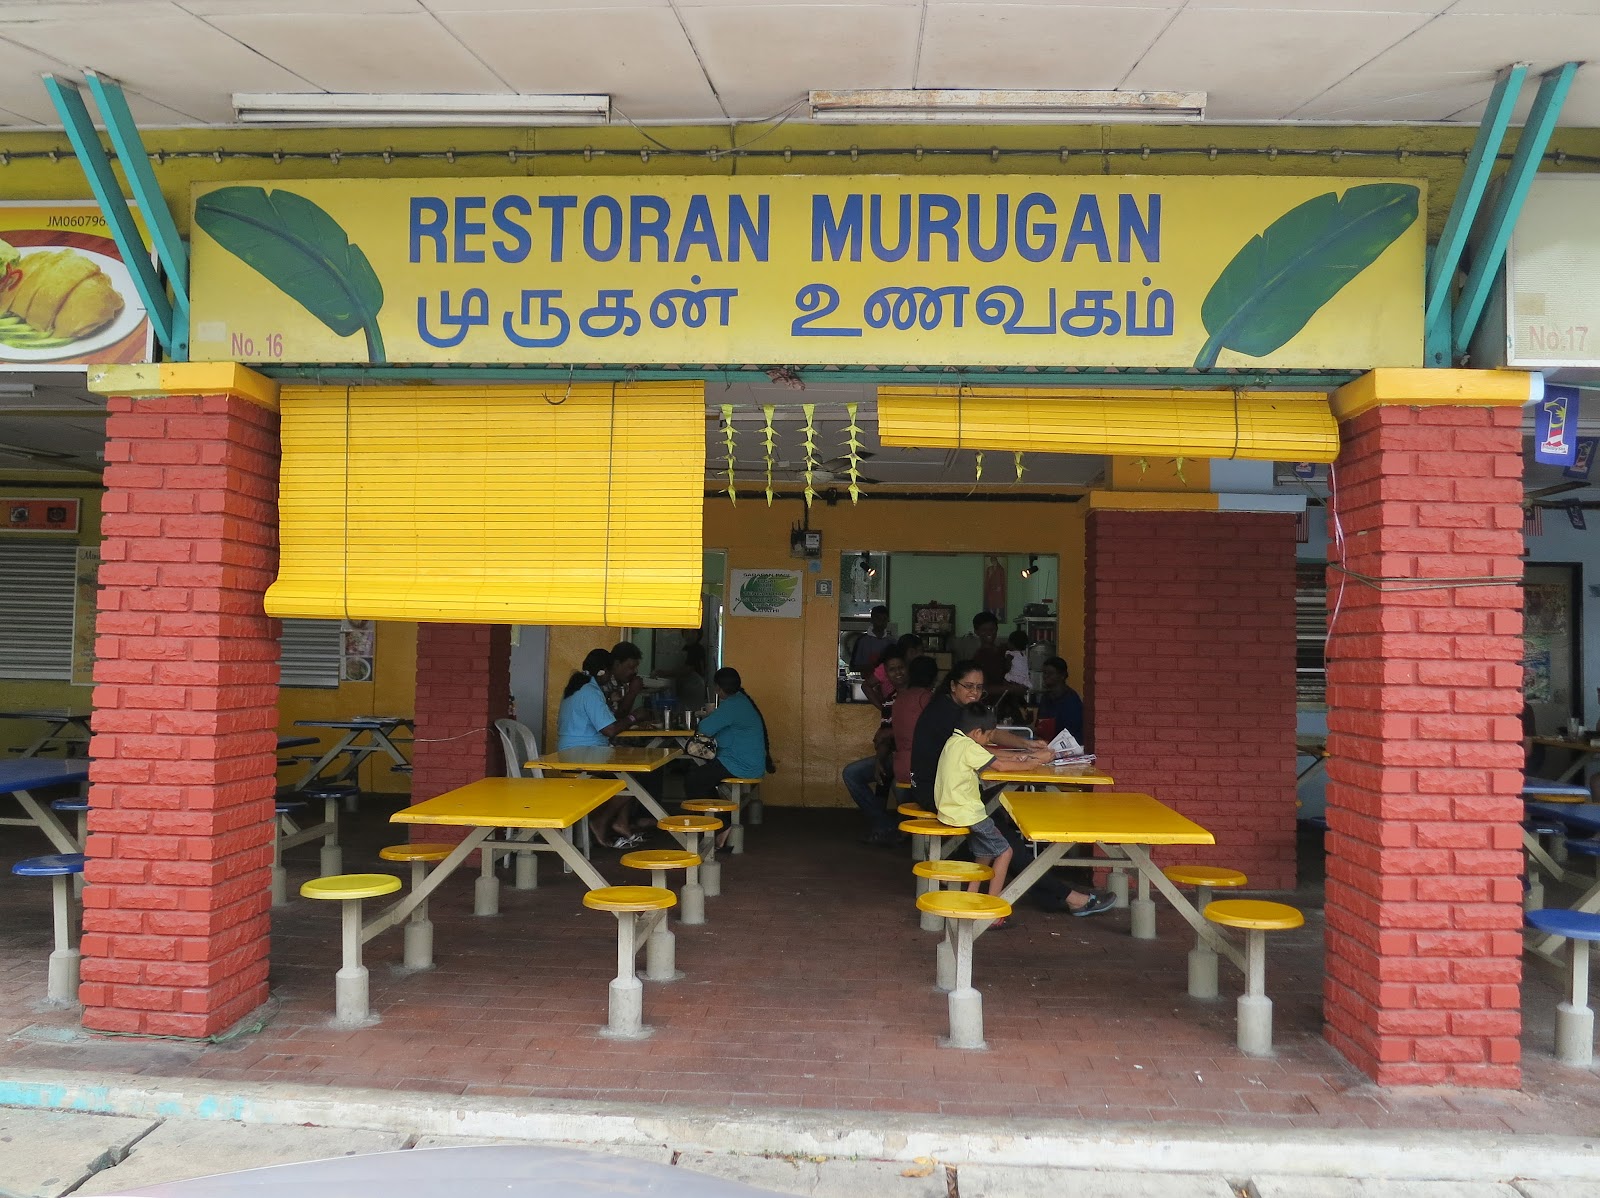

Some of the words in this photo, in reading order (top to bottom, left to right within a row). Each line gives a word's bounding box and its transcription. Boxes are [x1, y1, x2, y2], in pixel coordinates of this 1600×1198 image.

[46, 215, 109, 227] JM060796
[409, 194, 770, 263] RESTORAN
[811, 192, 1161, 263] MURUGAN
[417, 274, 738, 348] முருகன்
[791, 276, 1174, 337] உணவகம்
[266, 333, 283, 357] 16
